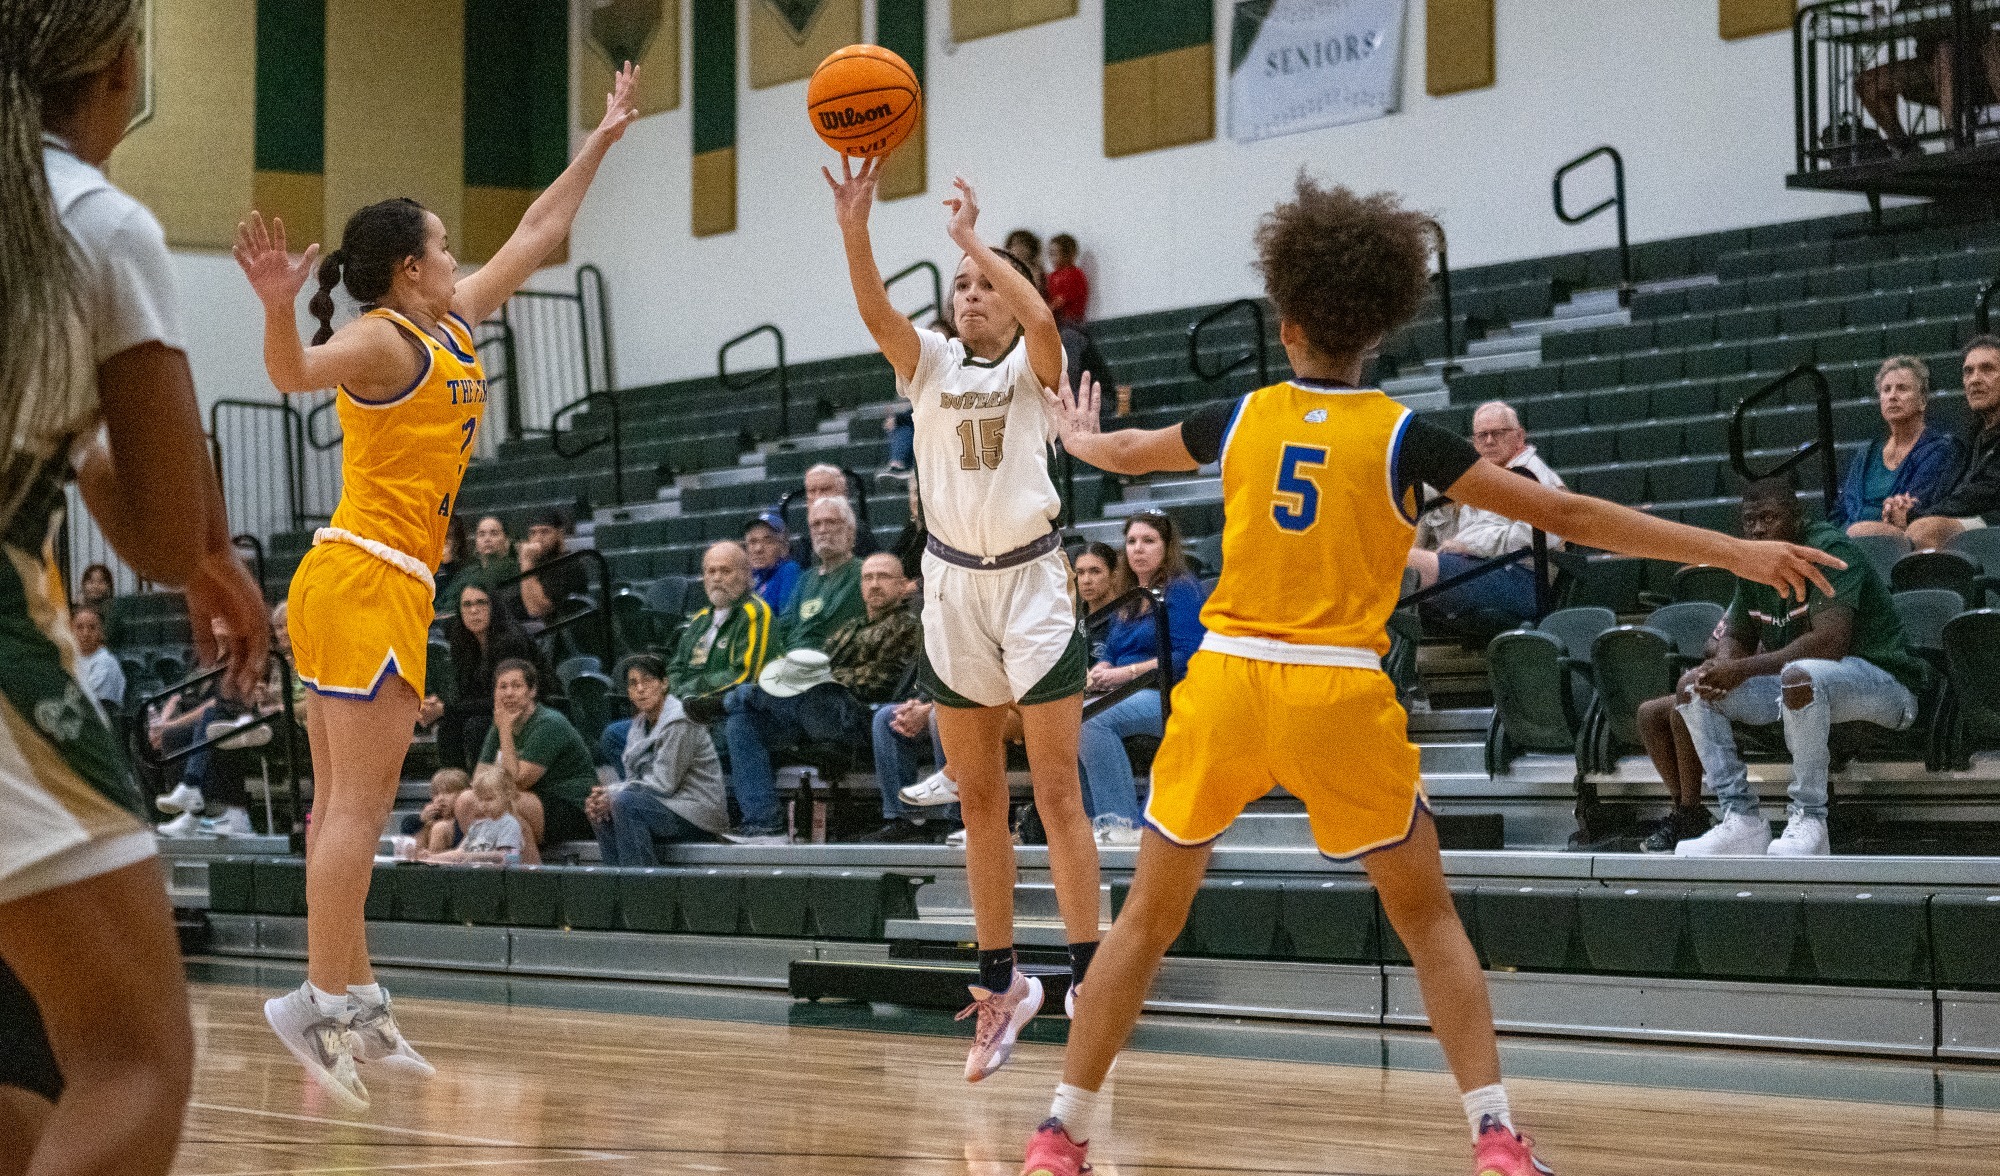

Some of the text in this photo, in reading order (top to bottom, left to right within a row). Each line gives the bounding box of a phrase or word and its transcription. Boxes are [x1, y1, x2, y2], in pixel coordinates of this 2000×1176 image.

[1265, 29, 1377, 78] SENIORS
[818, 103, 893, 130] Wilson
[956, 415, 1006, 470] 15
[1269, 440, 1331, 536] 5
